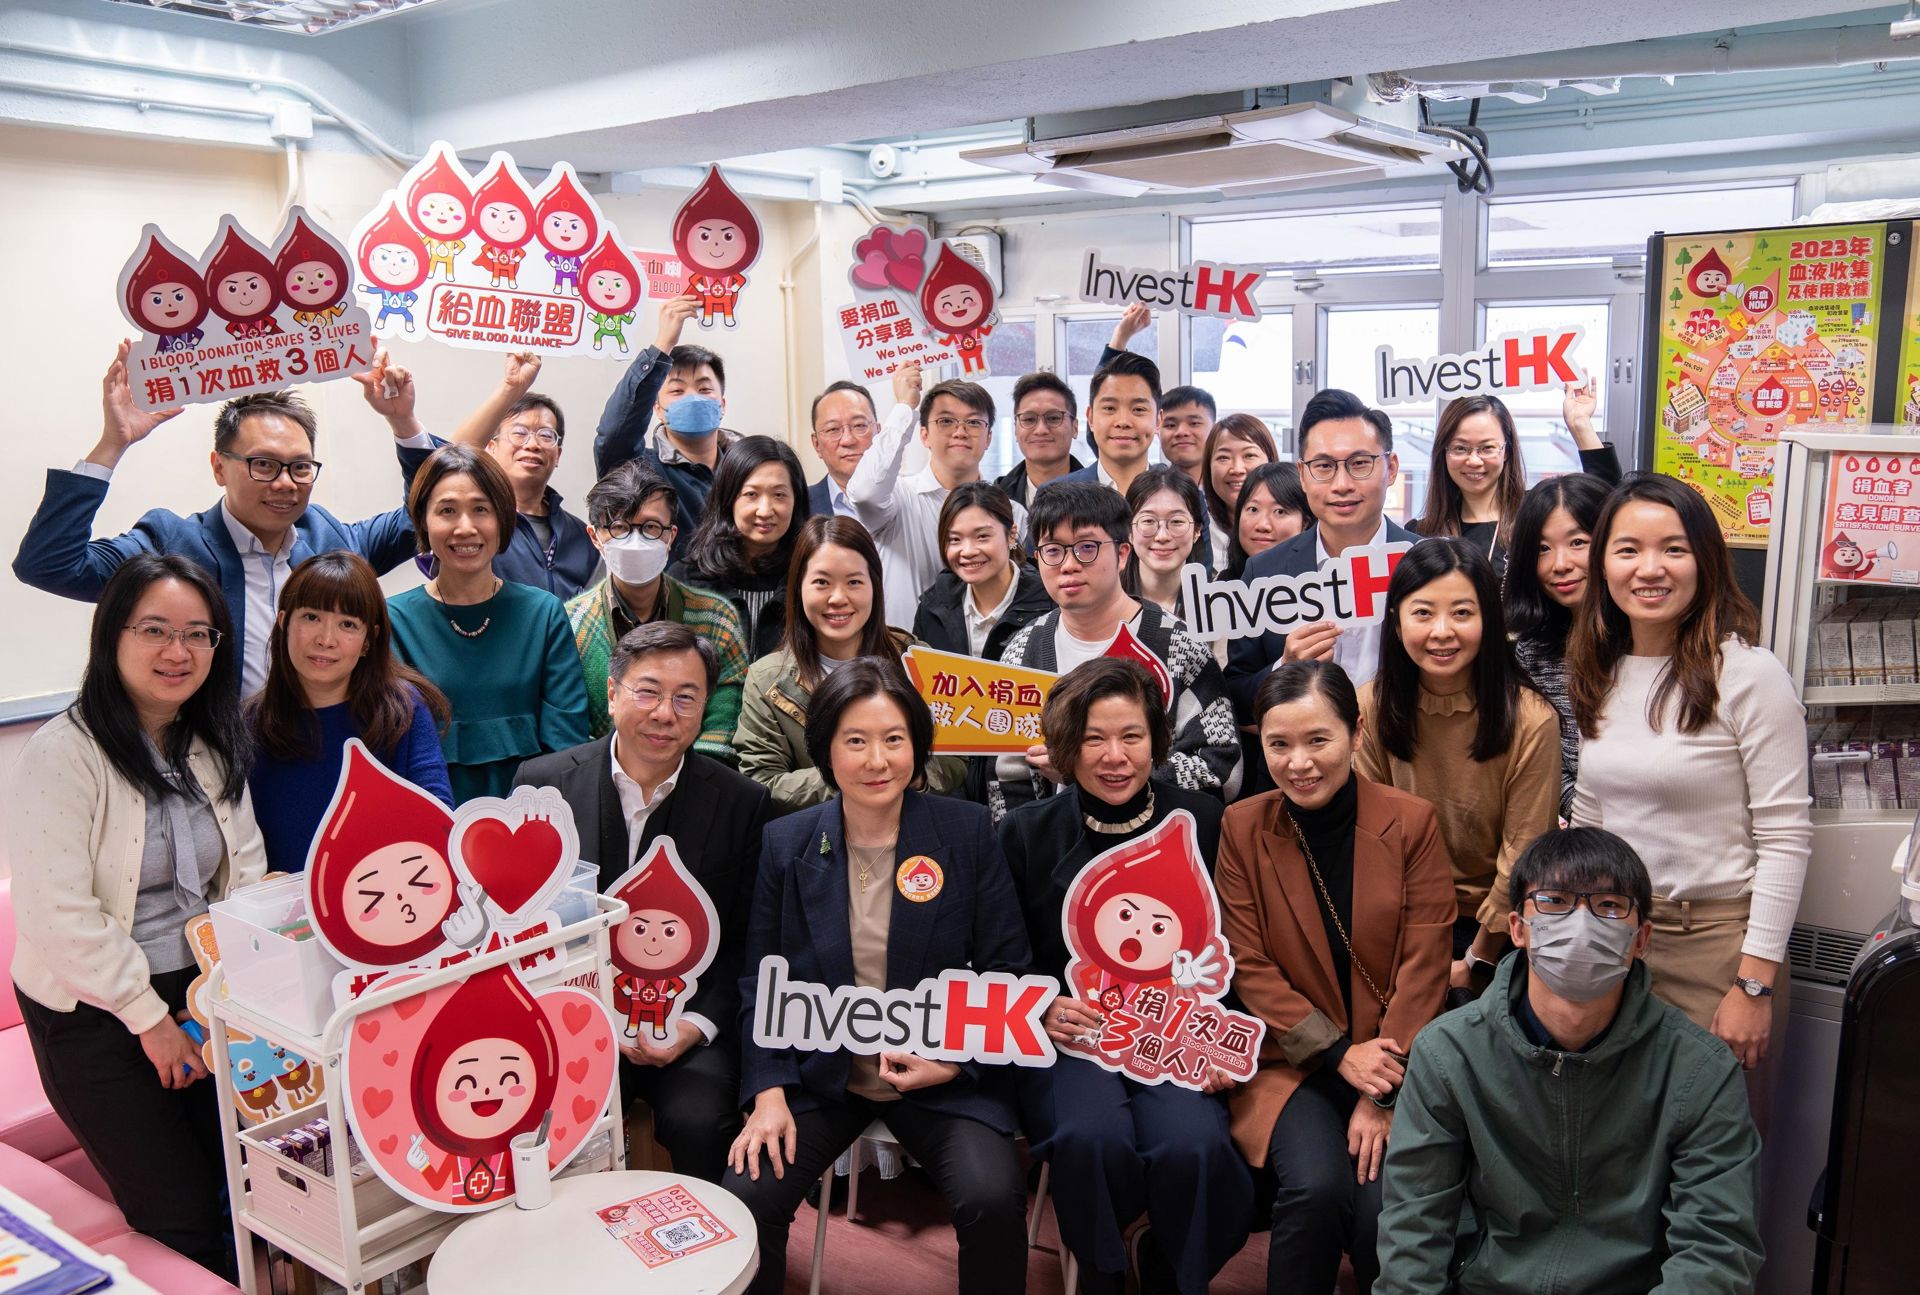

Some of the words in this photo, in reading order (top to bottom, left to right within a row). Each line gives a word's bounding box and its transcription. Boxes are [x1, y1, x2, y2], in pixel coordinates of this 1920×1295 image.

[1790, 236, 1871, 259] 2023年
[1085, 252, 1260, 317] InvestHK
[1788, 260, 1871, 281] 血液收集
[653, 281, 681, 294] BLOOD
[1787, 282, 1871, 300] 及使用數據
[437, 291, 575, 336] 給血聯盟
[840, 300, 900, 329] 愛捐血
[1749, 301, 1767, 310] NOW
[150, 351, 194, 370] BLOOD
[198, 341, 263, 361] DONATION
[266, 333, 304, 350] SAVES
[309, 325, 322, 342] 3
[327, 324, 361, 339] LIVES
[446, 329, 470, 341] GIVE
[472, 330, 509, 343] BLOOD
[510, 335, 563, 348] ALLIANCE
[856, 318, 914, 349] 分享愛
[876, 349, 895, 360] We
[897, 341, 928, 355] love,
[1382, 332, 1578, 398] InvestHK
[145, 344, 367, 404] 捐1次血救3個人
[864, 367, 883, 379] We
[886, 359, 921, 375] she
[924, 353, 953, 365] love.
[1855, 478, 1911, 495] 捐血者
[1868, 494, 1895, 502] DONOR
[1835, 521, 1889, 531] SATISFACTION
[1838, 504, 1920, 523] 意見調查
[1191, 552, 1406, 634] InvestH
[931, 672, 1043, 707] 加入捐血
[928, 701, 1043, 739] 救人團隊
[764, 966, 1049, 1057] InvestHK
[1135, 986, 1254, 1056] 捐1次血
[1096, 1010, 1206, 1078] 3個人!
[1181, 1035, 1207, 1053] Blood
[1208, 1046, 1247, 1070] Donation
[1131, 1057, 1155, 1074] Lives
